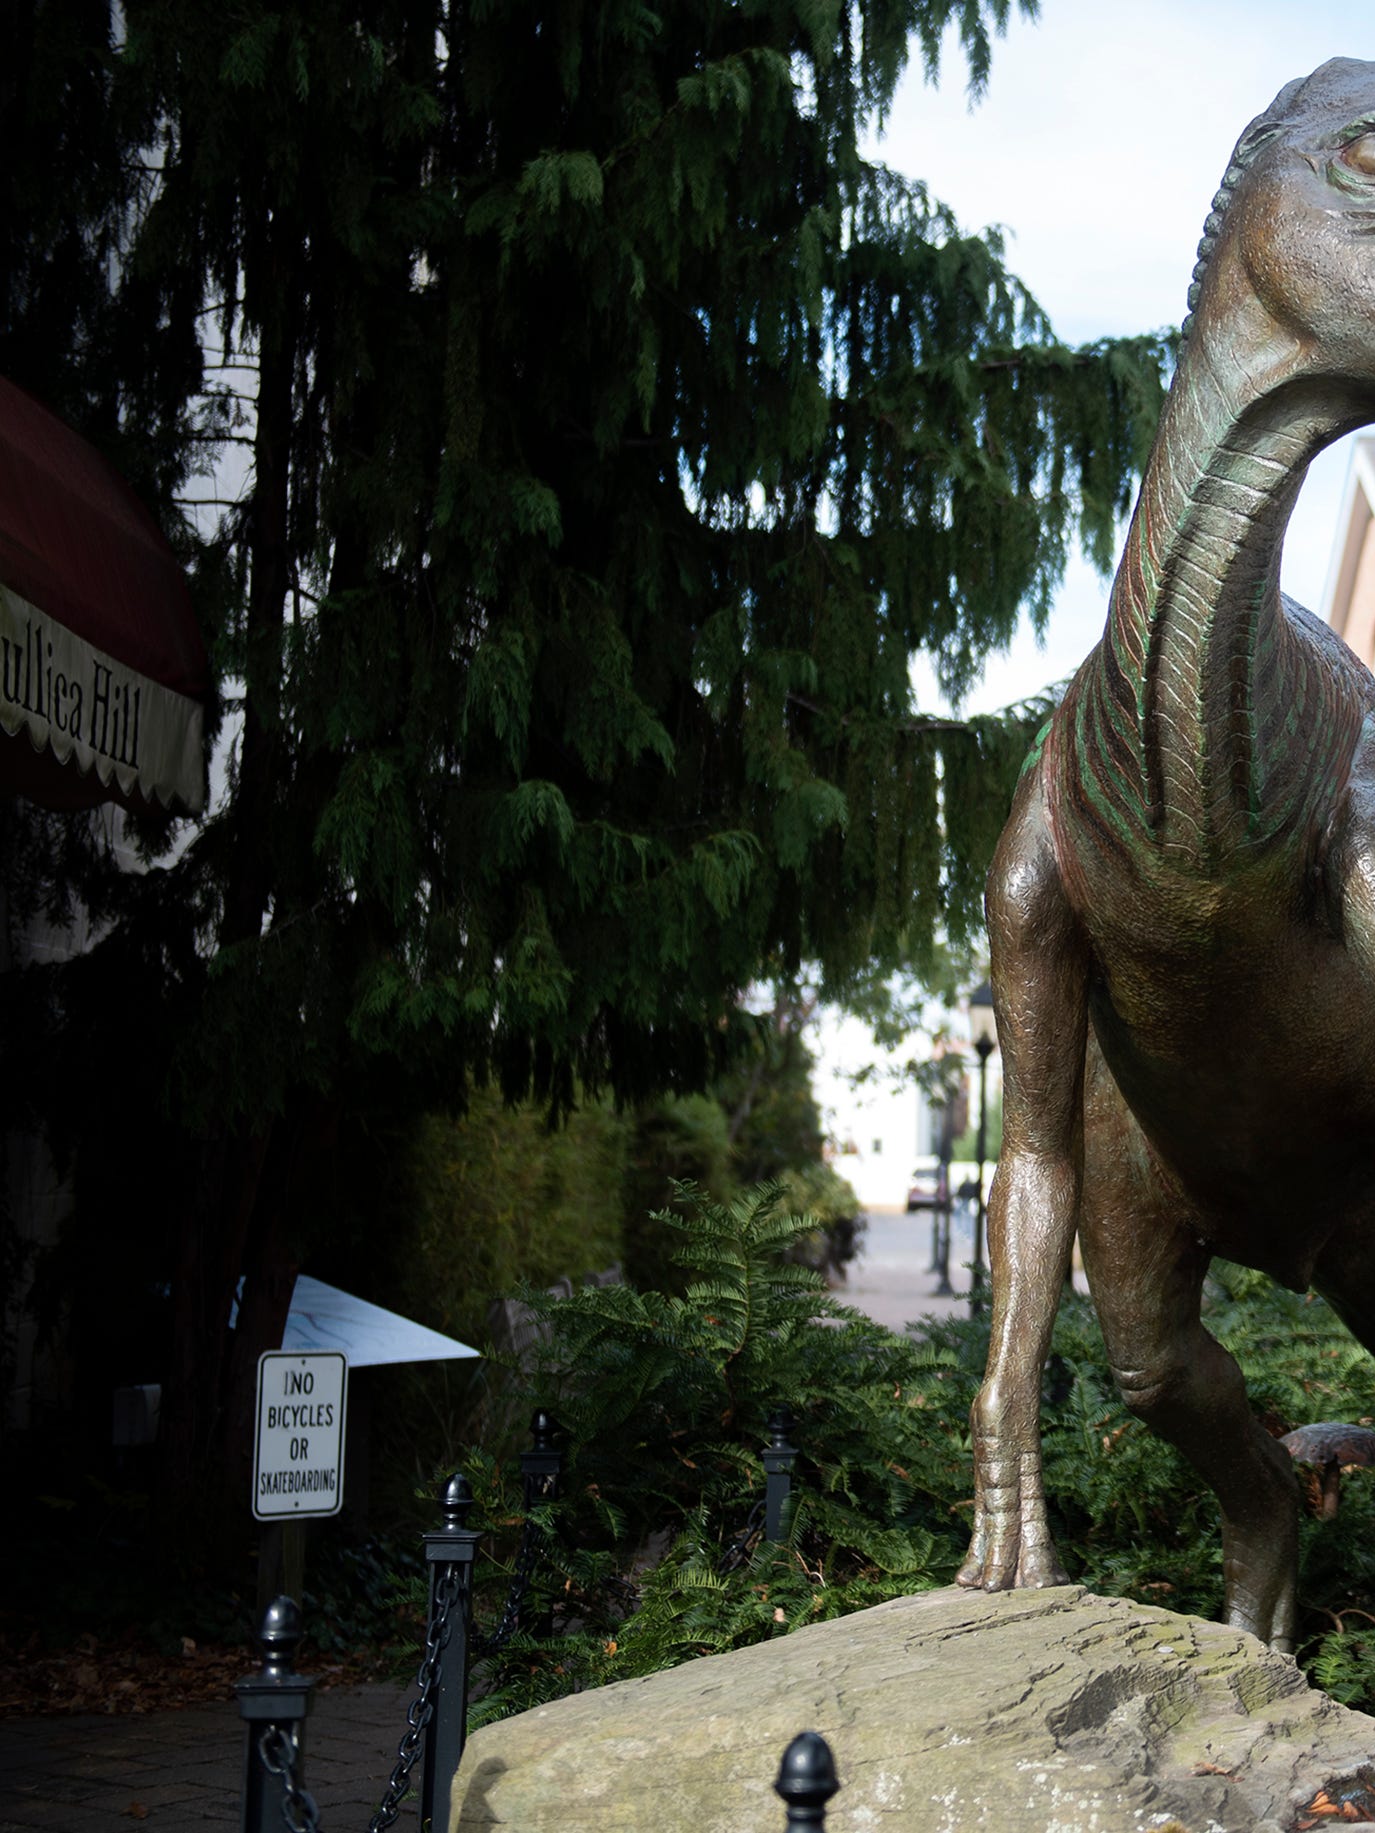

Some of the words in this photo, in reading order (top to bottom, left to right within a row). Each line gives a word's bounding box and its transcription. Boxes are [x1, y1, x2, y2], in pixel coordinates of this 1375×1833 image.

[89, 659, 141, 771] Hill
[268, 1404, 334, 1429] BICYCLES
[289, 1437, 309, 1461] OR
[260, 1468, 336, 1496] SKATEBOARDING
